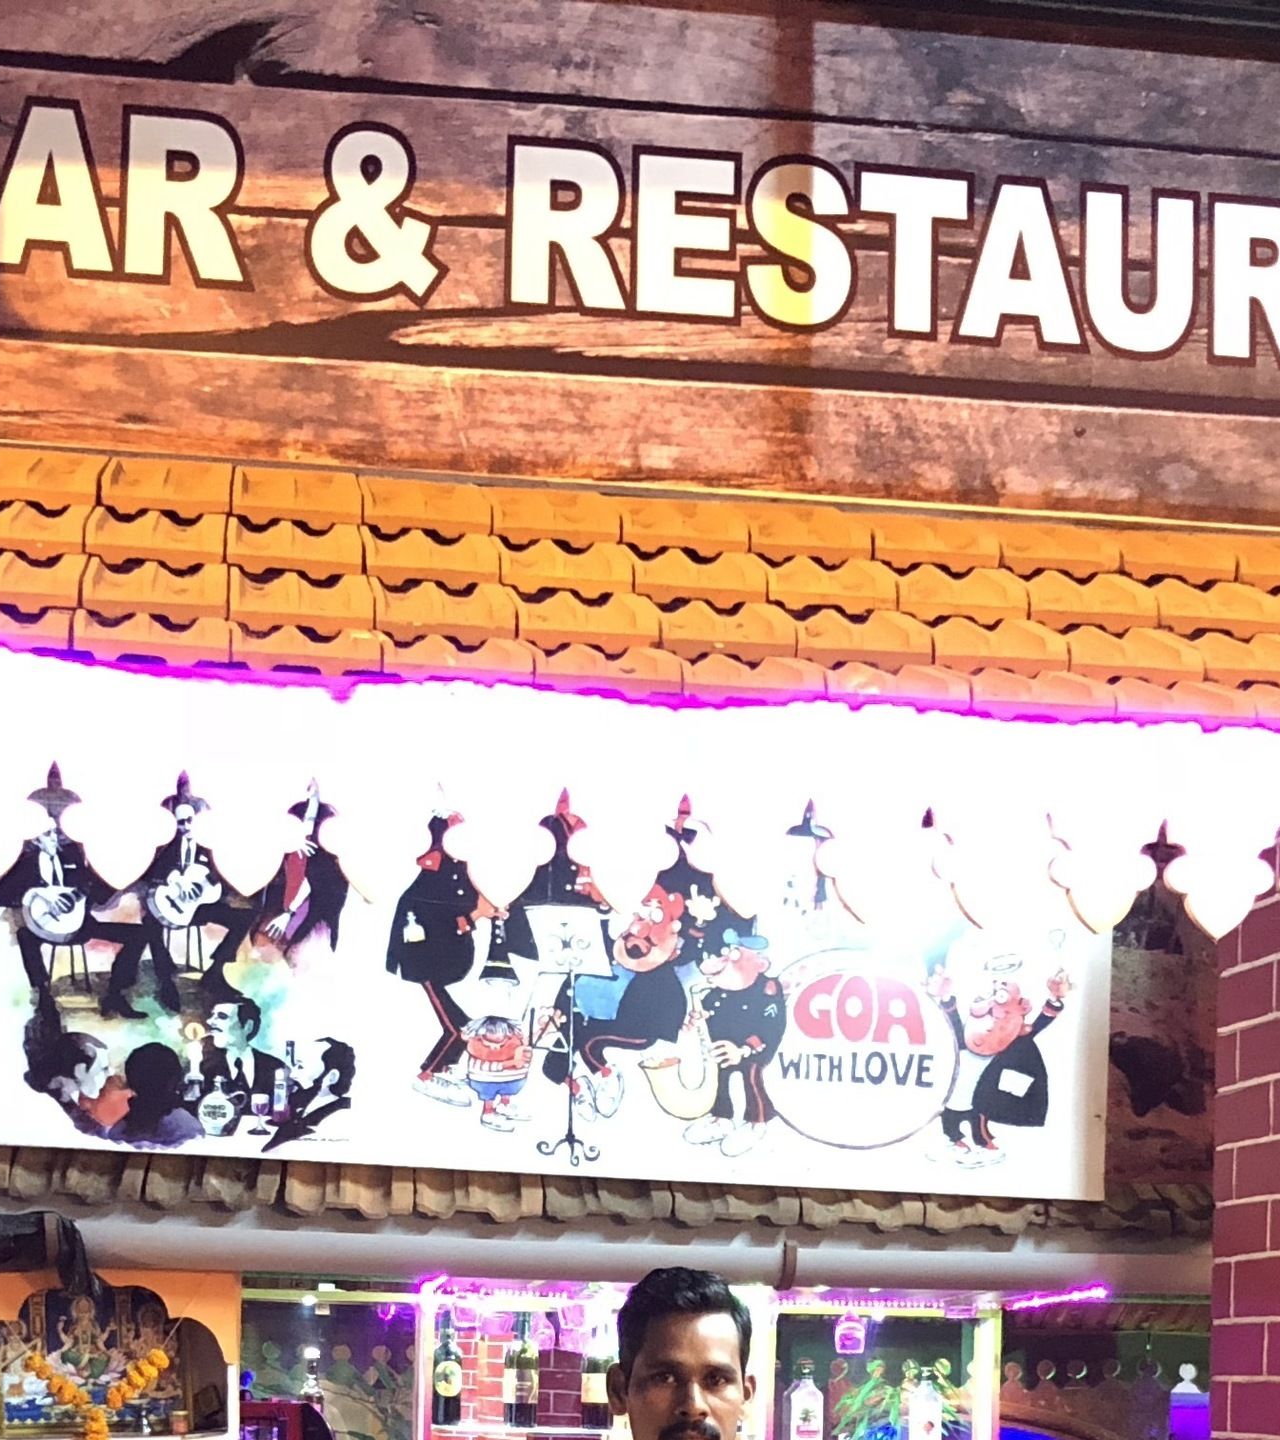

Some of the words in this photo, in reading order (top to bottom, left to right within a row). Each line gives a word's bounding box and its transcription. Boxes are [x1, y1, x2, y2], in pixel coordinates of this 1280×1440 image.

[308, 122, 448, 304] &
[793, 974, 926, 1045] GOA
[778, 1052, 843, 1082] WITH
[851, 1051, 934, 1088] LOVE
